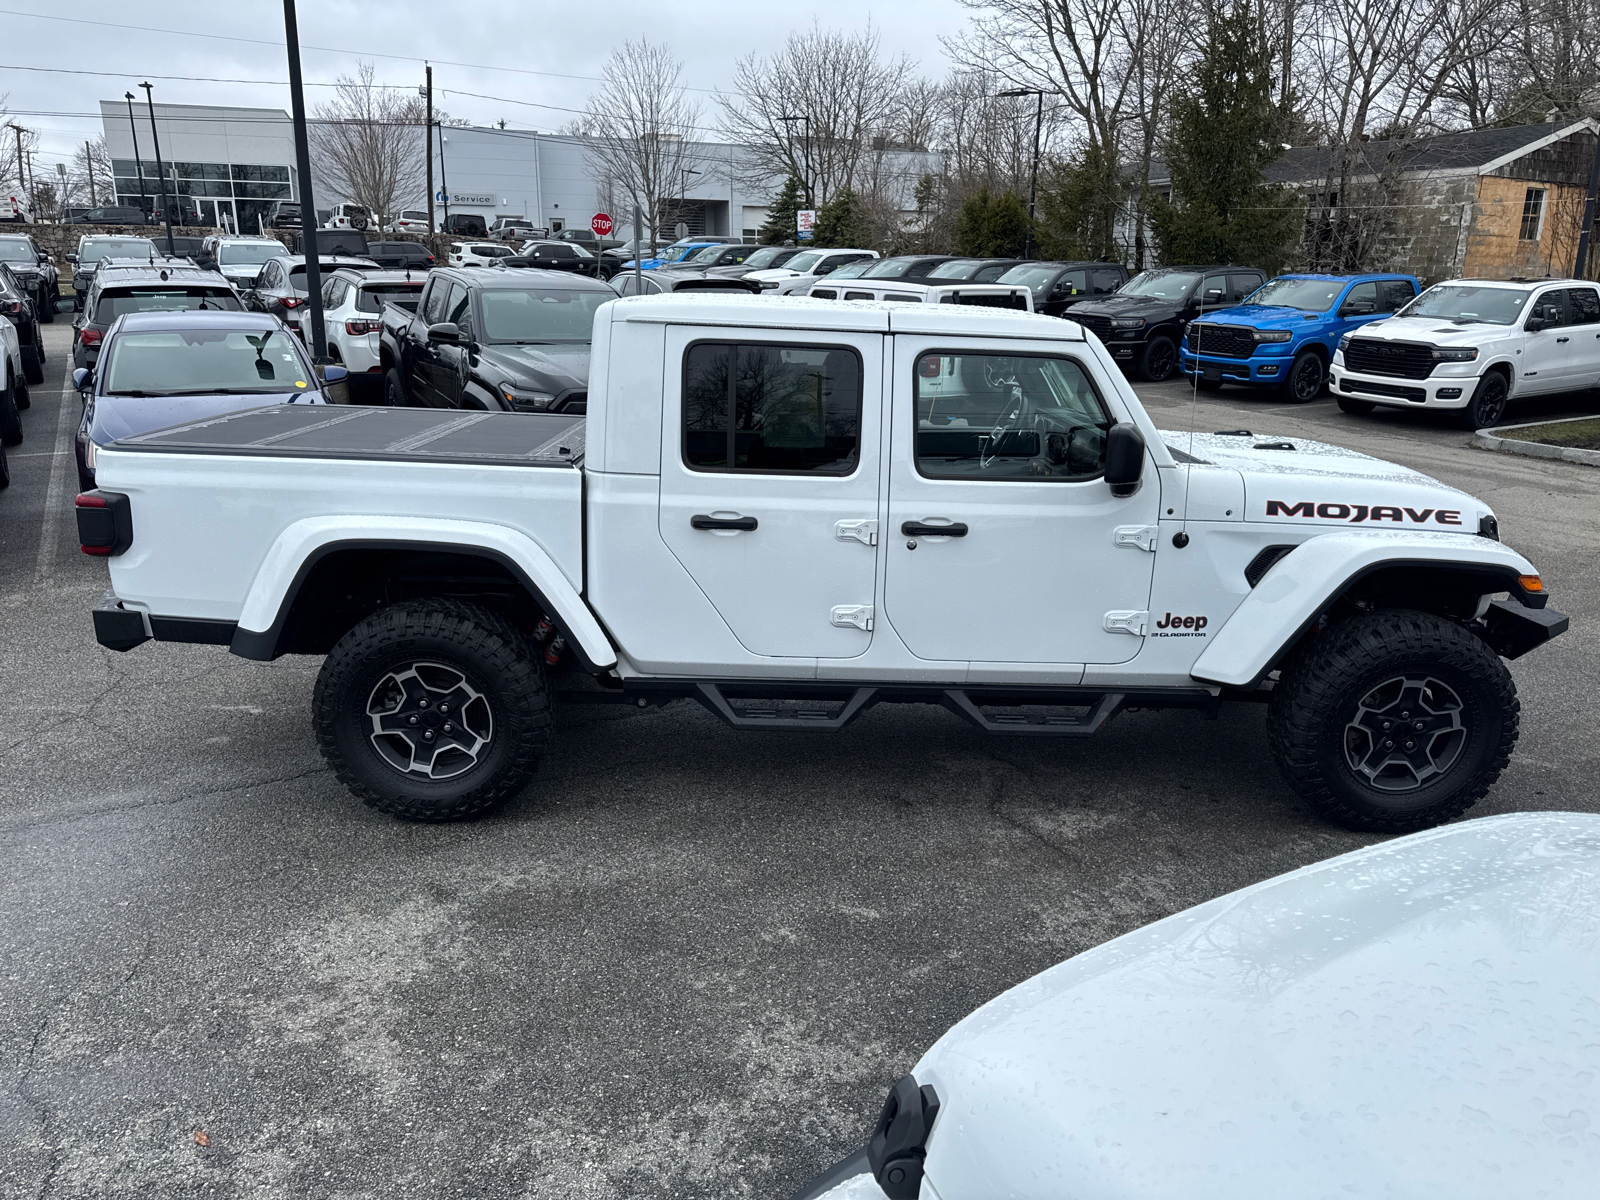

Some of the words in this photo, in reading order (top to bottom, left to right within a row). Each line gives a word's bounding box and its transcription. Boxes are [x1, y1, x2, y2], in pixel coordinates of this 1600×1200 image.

[592, 219, 612, 229] STOP
[1365, 345, 1406, 356] RAM
[1266, 500, 1462, 525] MOJAVE
[1156, 612, 1208, 631] Jeep
